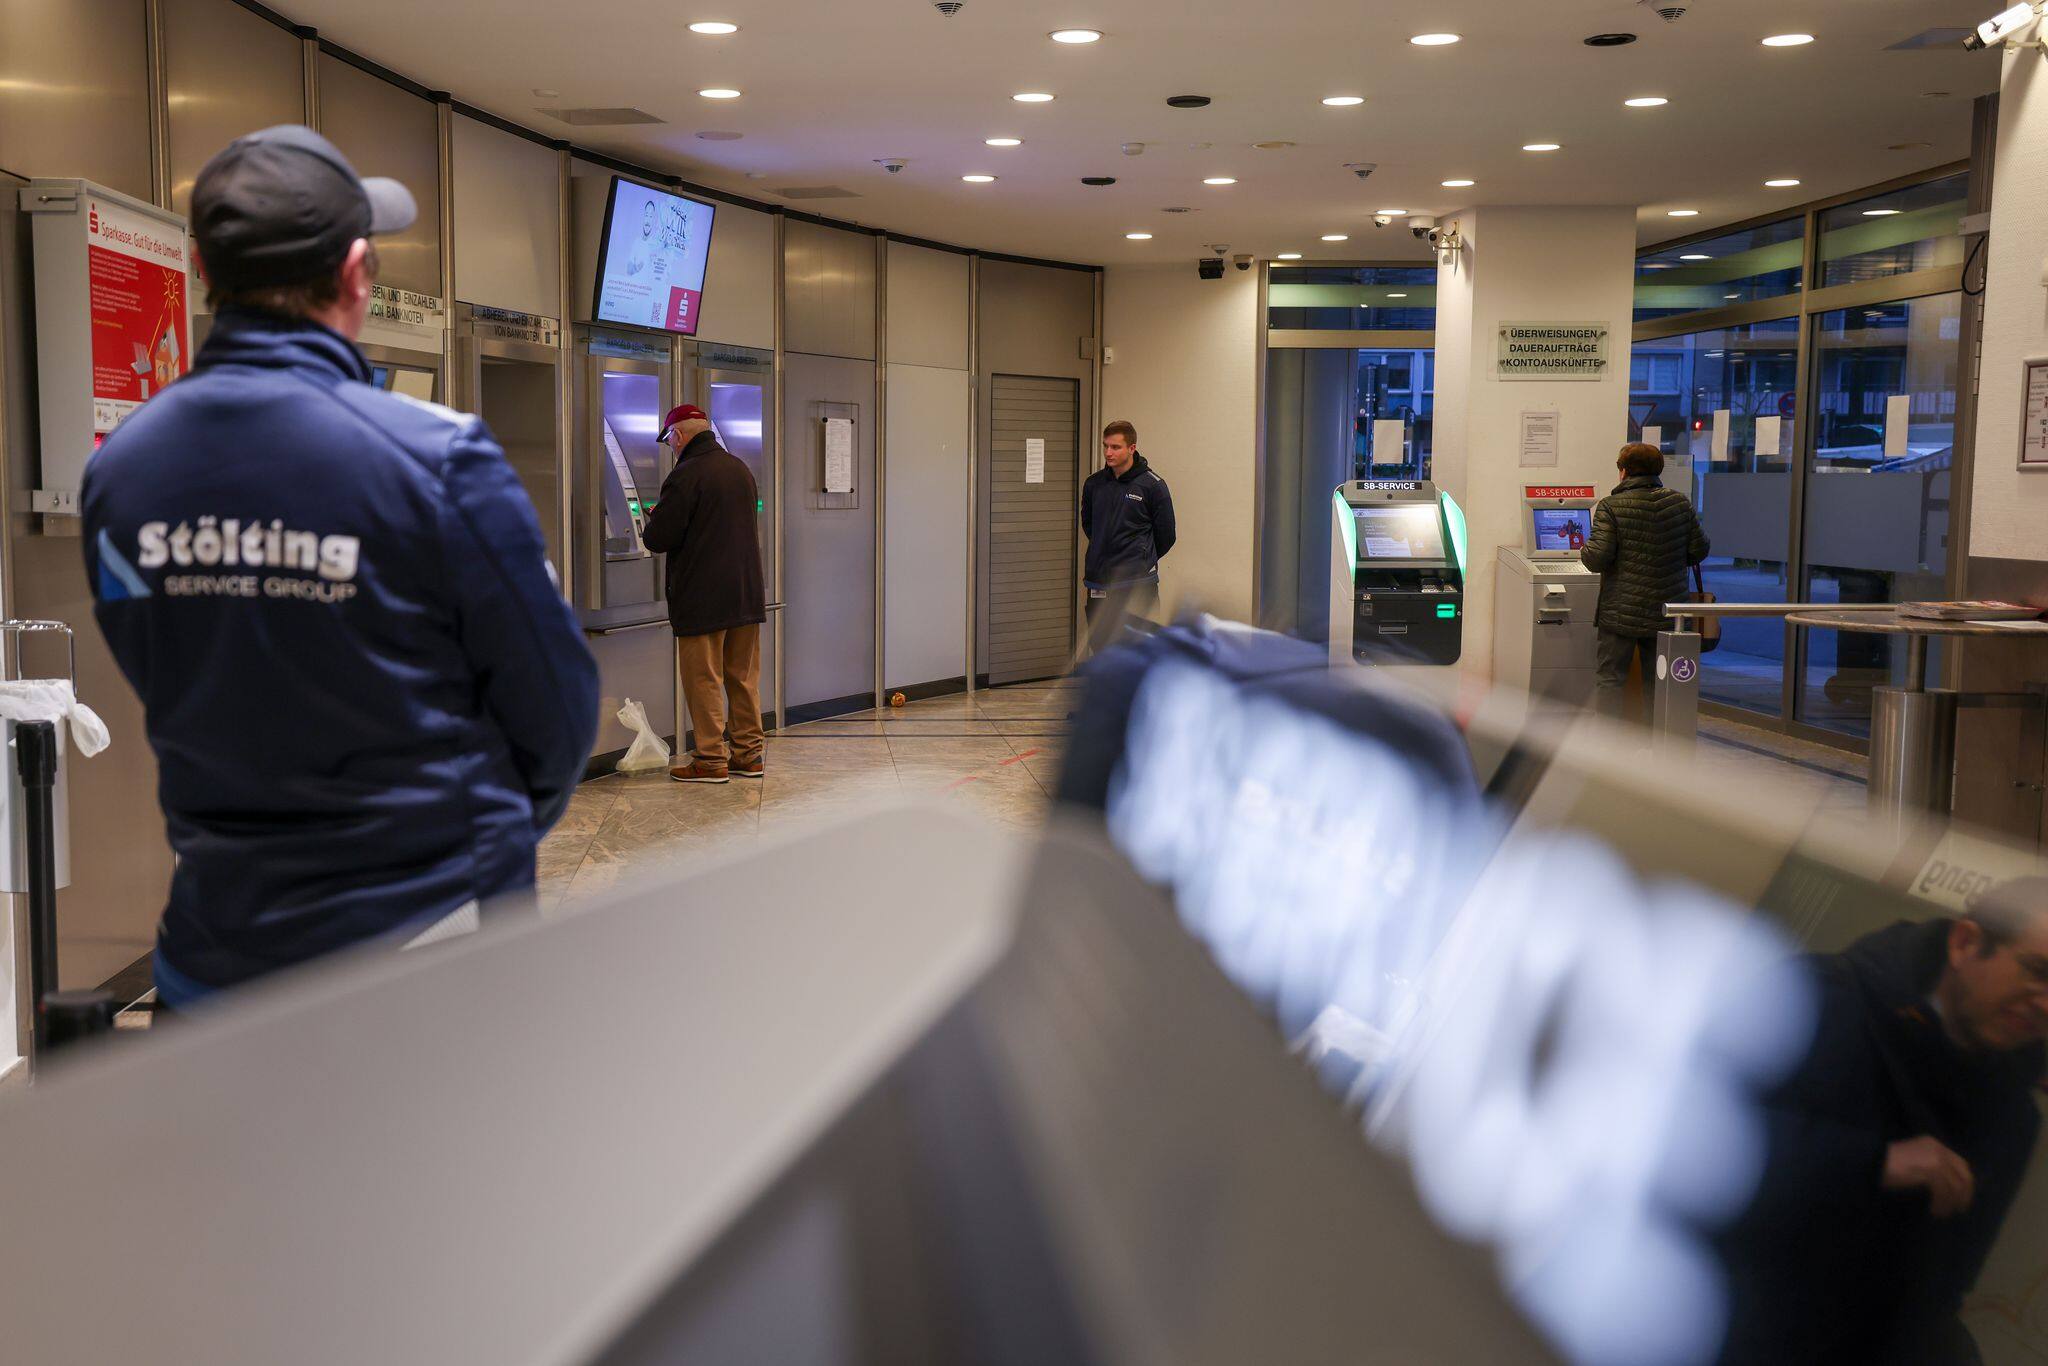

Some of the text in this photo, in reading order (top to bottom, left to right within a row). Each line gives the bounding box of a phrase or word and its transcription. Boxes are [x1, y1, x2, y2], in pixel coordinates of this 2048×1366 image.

[101, 221, 132, 245] Sparkasse.
[133, 232, 145, 249] Gut
[153, 240, 162, 255] die
[371, 285, 437, 310] BEN UND EINZAHLEN
[370, 301, 425, 325] VON BANKNOTEN
[494, 325, 540, 342] VON BANKNOTEN
[1510, 328, 1597, 338] ÜBERWEISUNGEN
[1509, 343, 1598, 353] DAUERAUFTRÄGE
[1506, 357, 1600, 367] KONTOAUSKÜNFTE
[1363, 482, 1415, 490] SB-SERVICE
[1535, 488, 1586, 497] SB-SERVICE
[137, 515, 360, 582] Stölting
[164, 575, 358, 603] SERVICE GROUP
